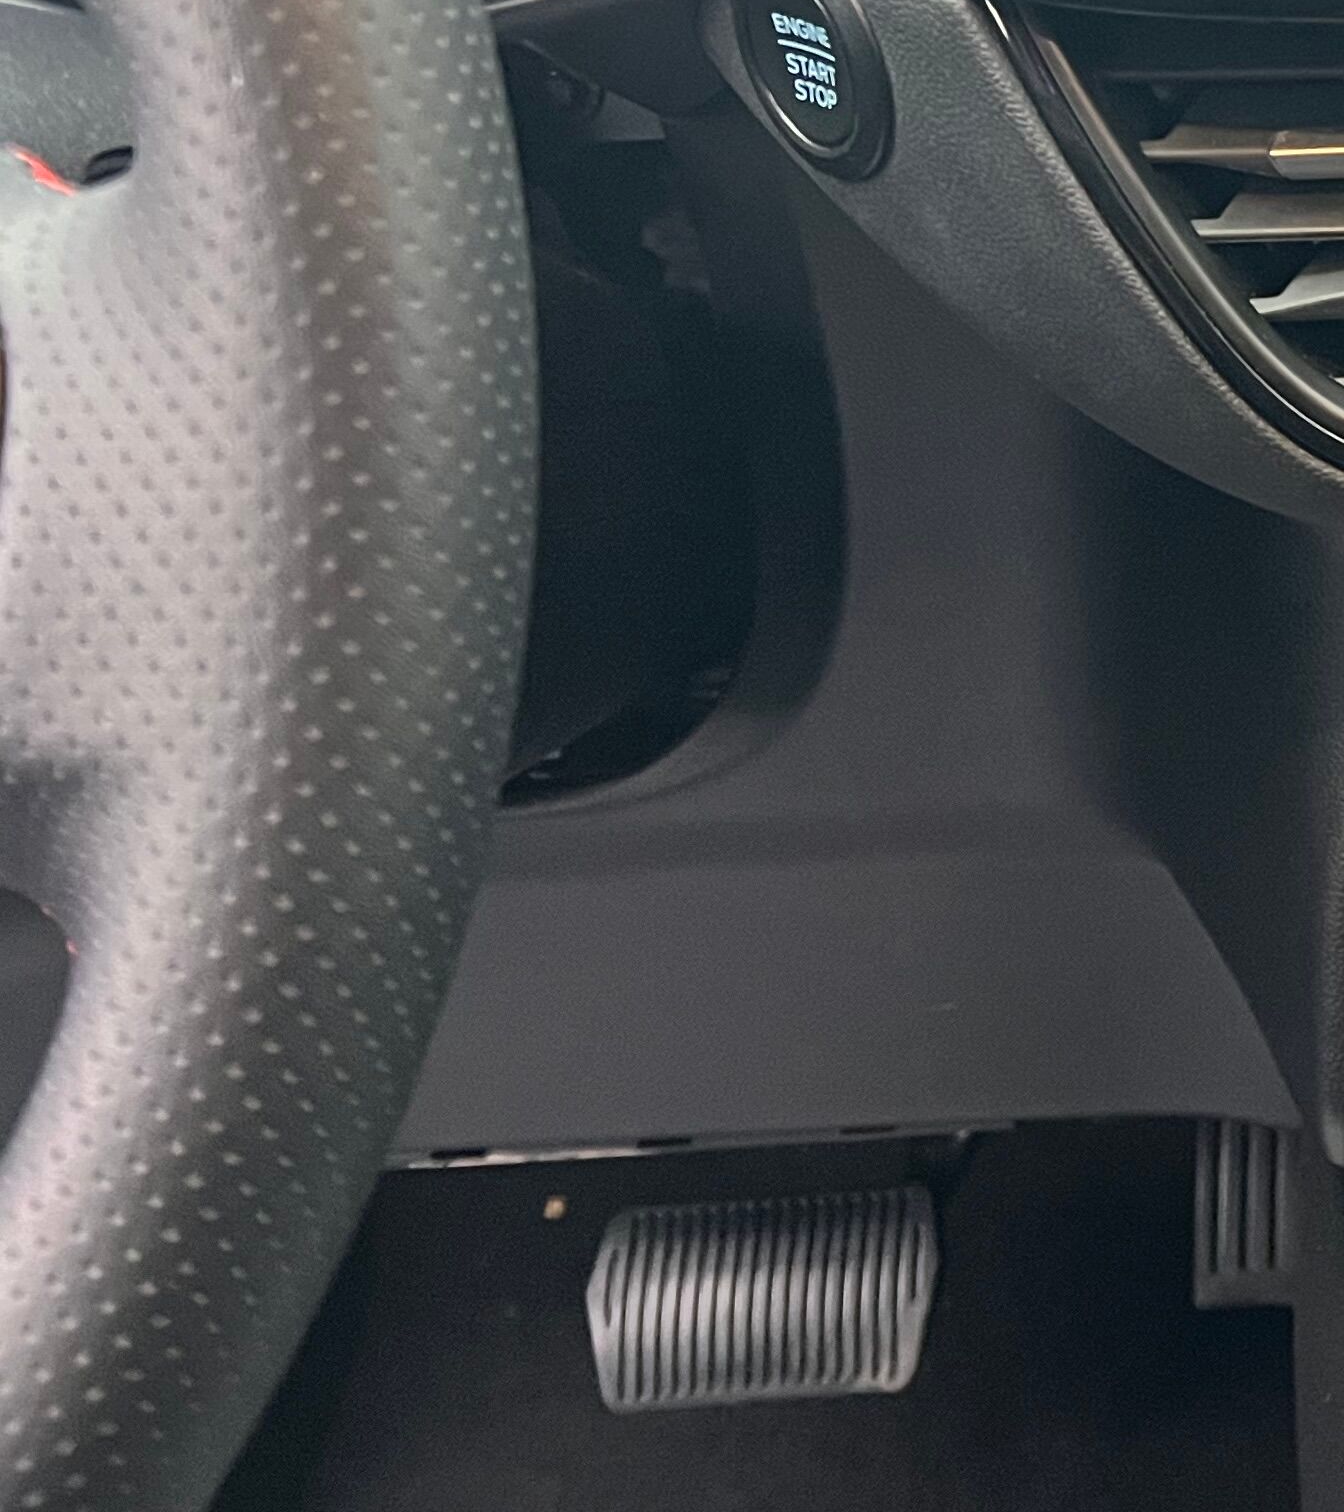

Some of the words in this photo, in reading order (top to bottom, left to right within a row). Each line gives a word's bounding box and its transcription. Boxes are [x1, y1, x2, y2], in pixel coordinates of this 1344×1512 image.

[771, 12, 831, 48] ENGINE
[785, 52, 836, 86] START
[794, 78, 837, 110] STOP
